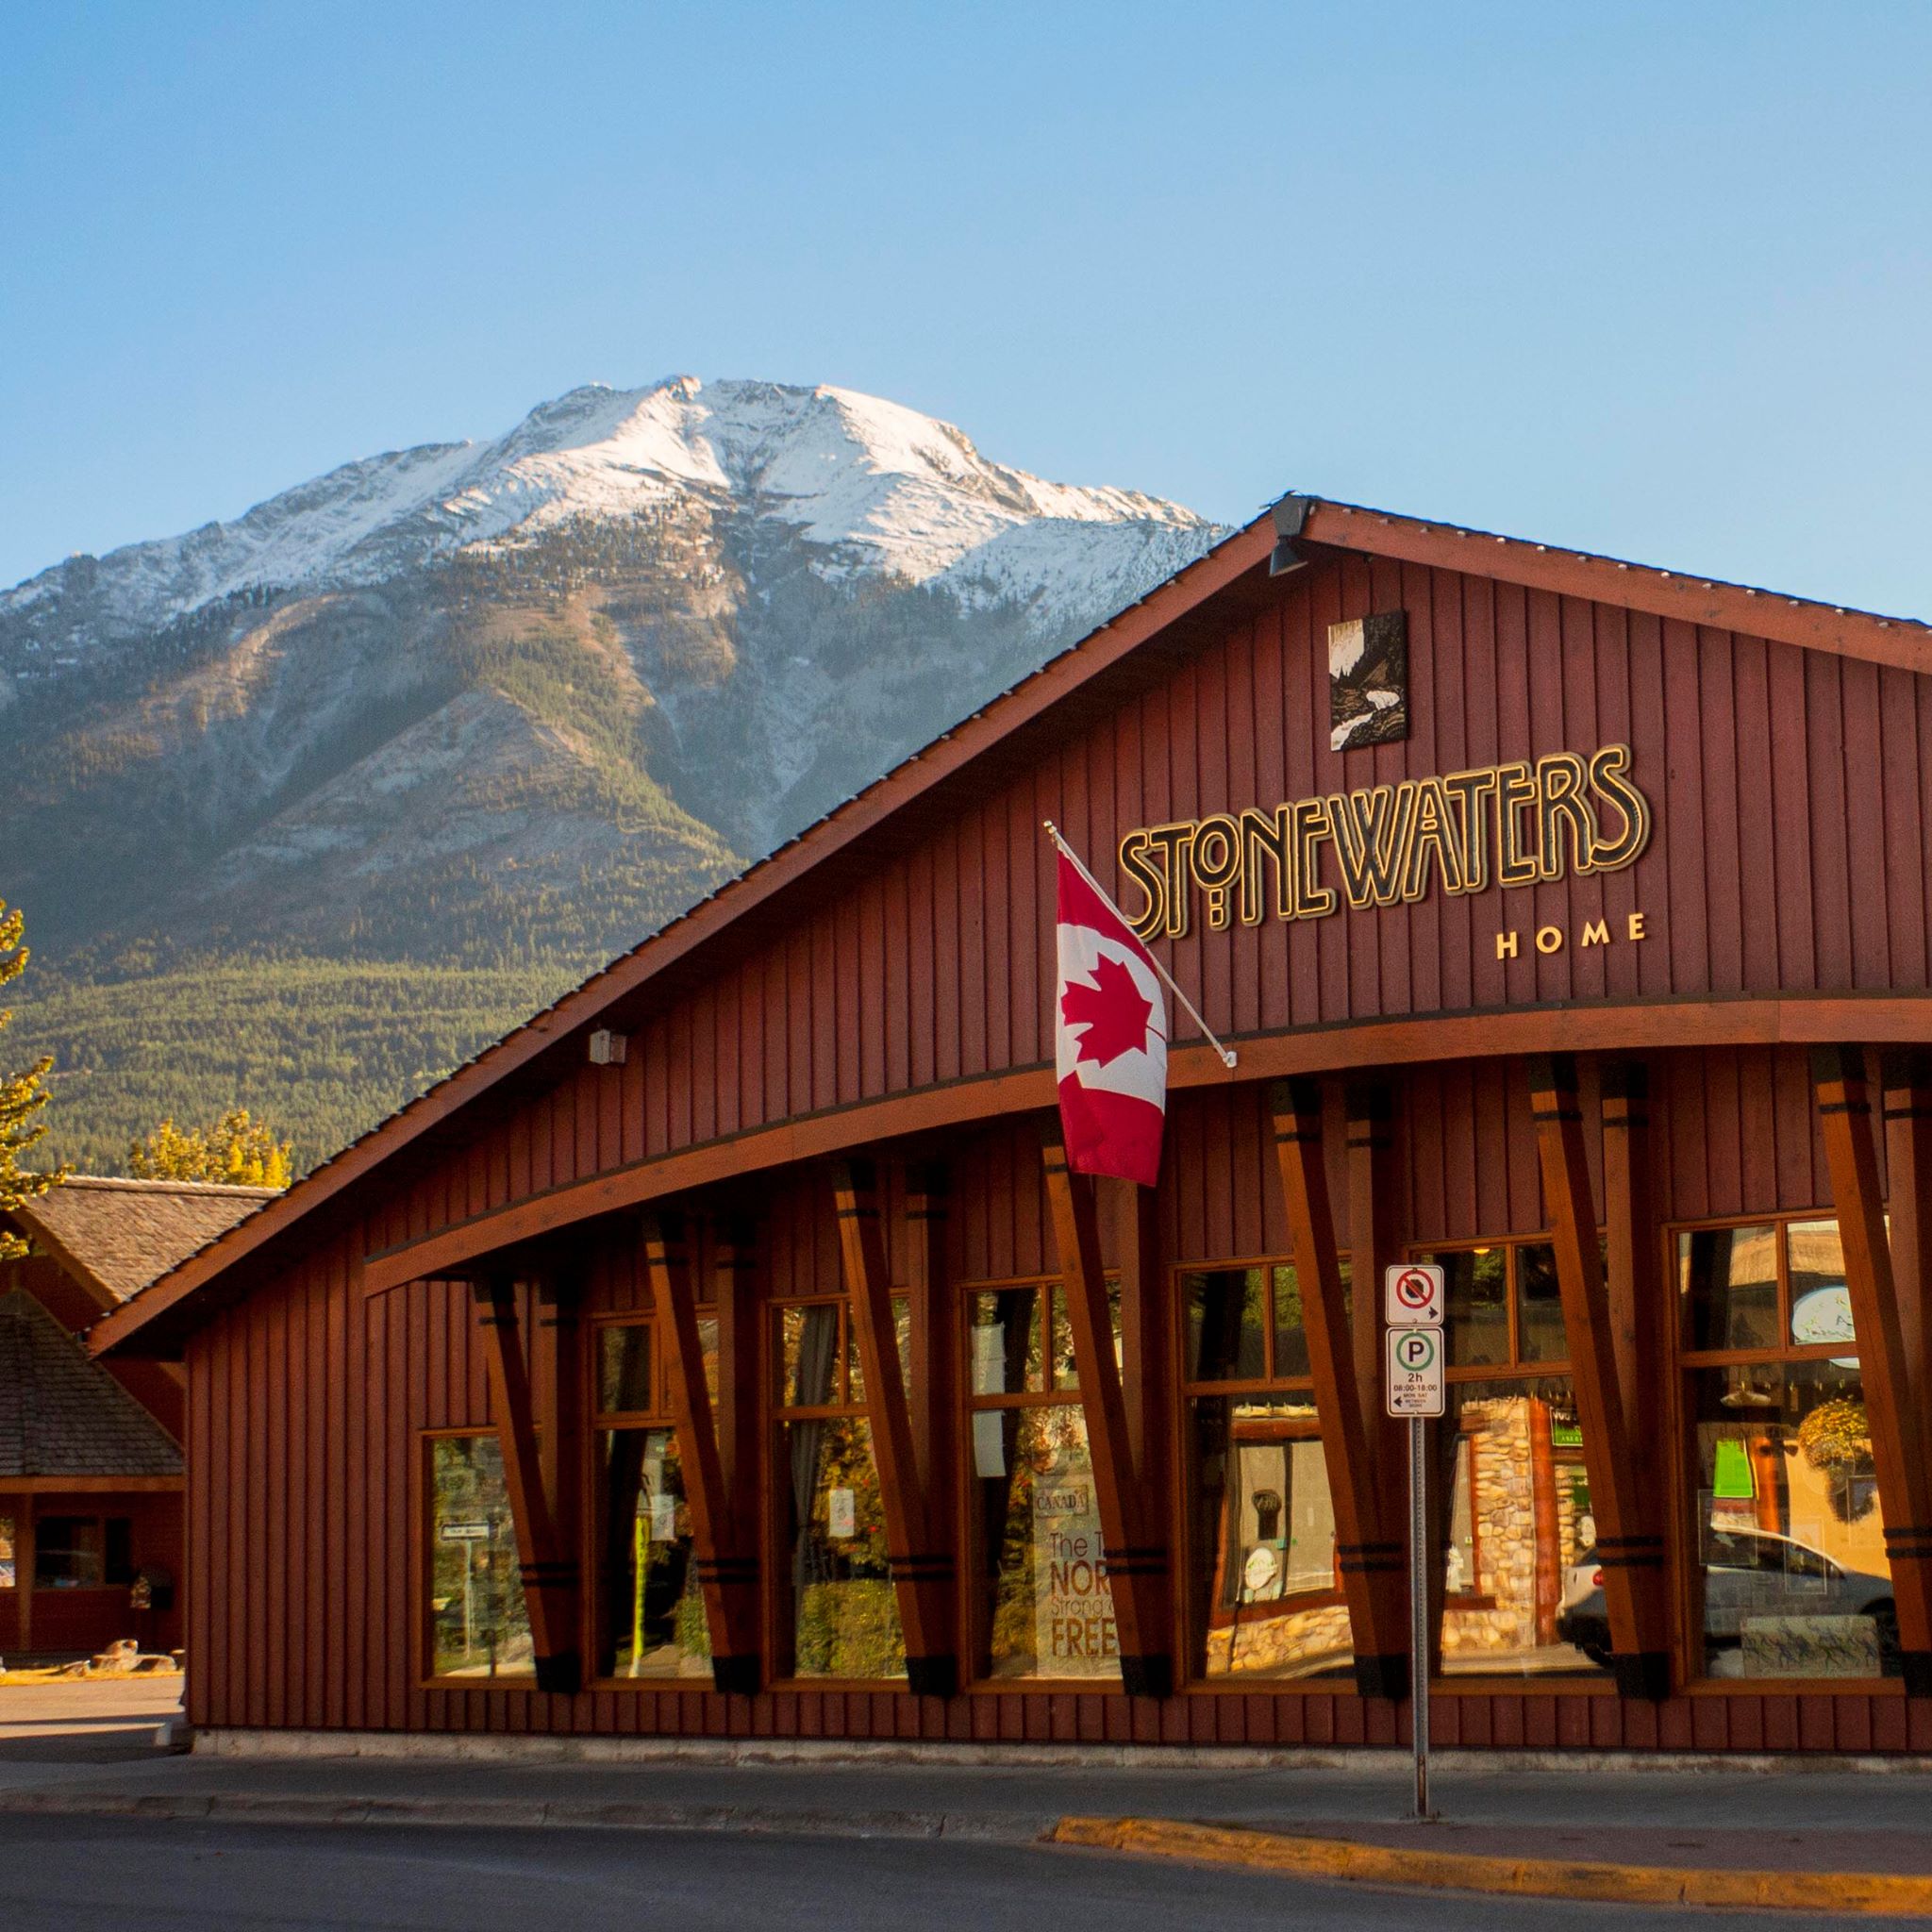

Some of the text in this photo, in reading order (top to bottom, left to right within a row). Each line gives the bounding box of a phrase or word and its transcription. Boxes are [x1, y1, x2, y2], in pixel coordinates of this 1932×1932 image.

[1120, 742, 1652, 941] STONEWATERS
[1496, 912, 1645, 959] HOME
[1408, 1341, 1424, 1362] P
[1407, 1373, 1423, 1383] 2h
[1050, 1532, 1088, 1557] The
[1050, 1560, 1110, 1596] NOR
[1051, 1596, 1103, 1621] Strong
[1052, 1617, 1117, 1657] FREE
